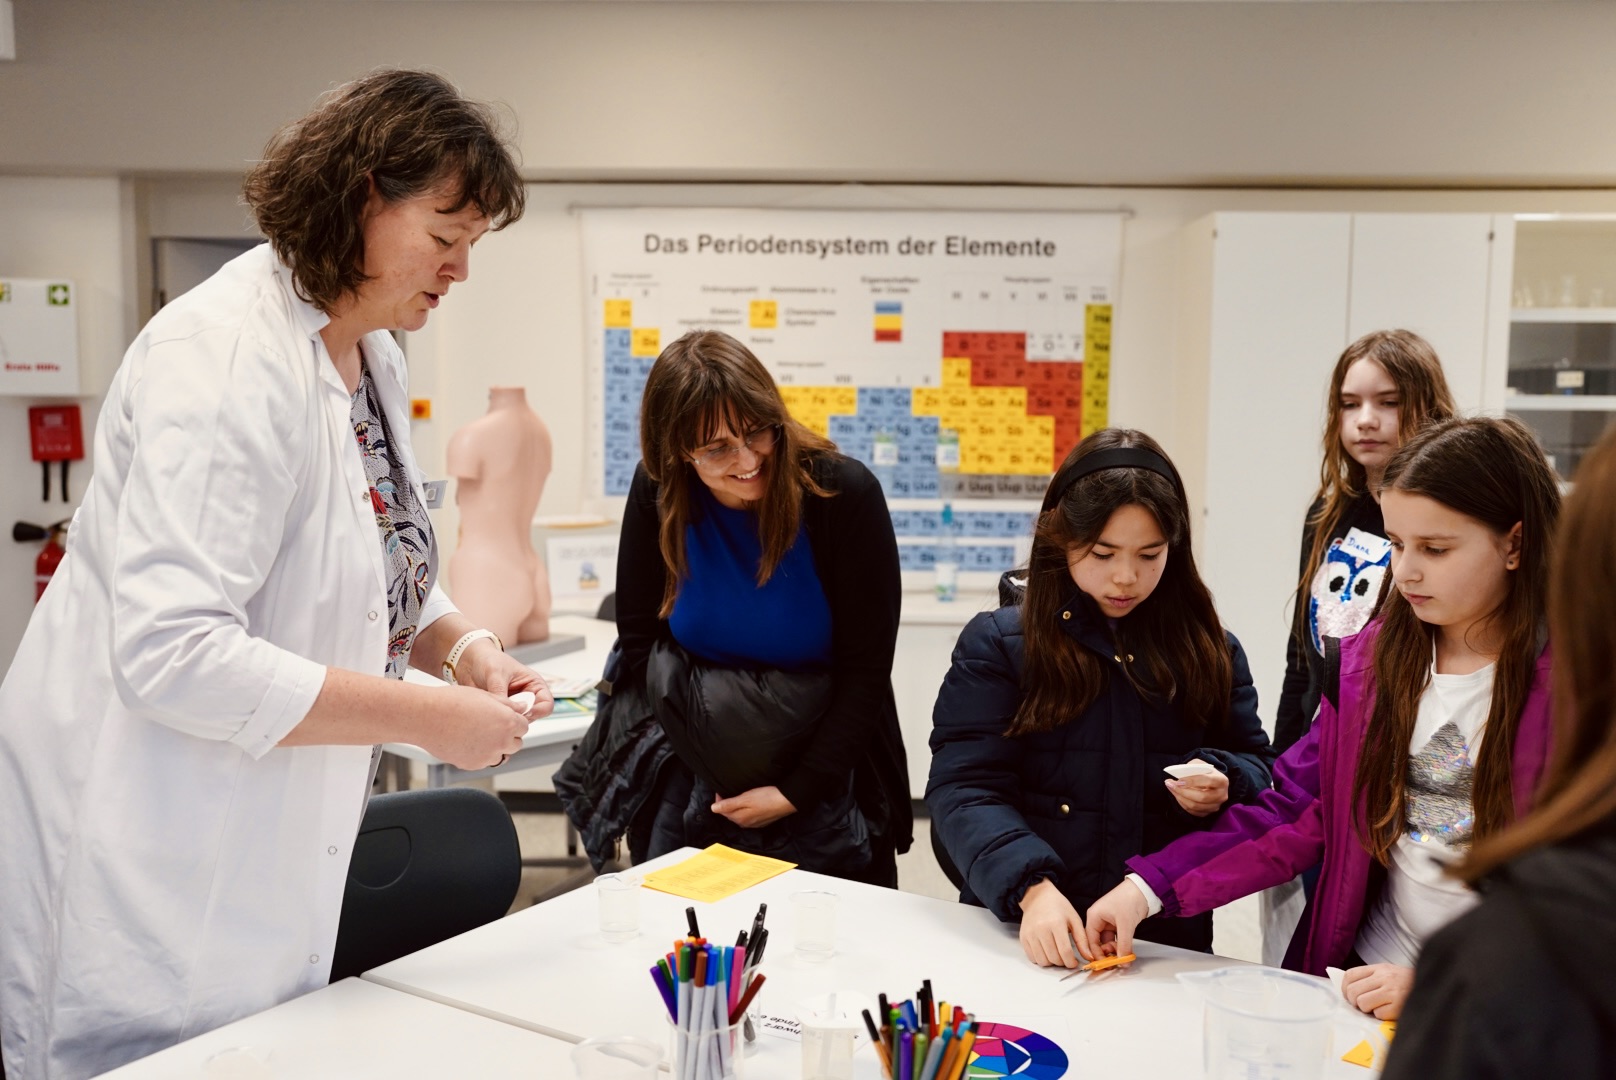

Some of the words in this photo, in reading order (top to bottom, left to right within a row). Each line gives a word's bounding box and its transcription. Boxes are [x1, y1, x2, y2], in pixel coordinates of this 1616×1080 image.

[644, 233, 688, 255] Das
[698, 233, 889, 260] Periodensystem
[898, 235, 936, 256] der
[945, 235, 1057, 257] Elemente
[1043, 340, 1054, 351] O
